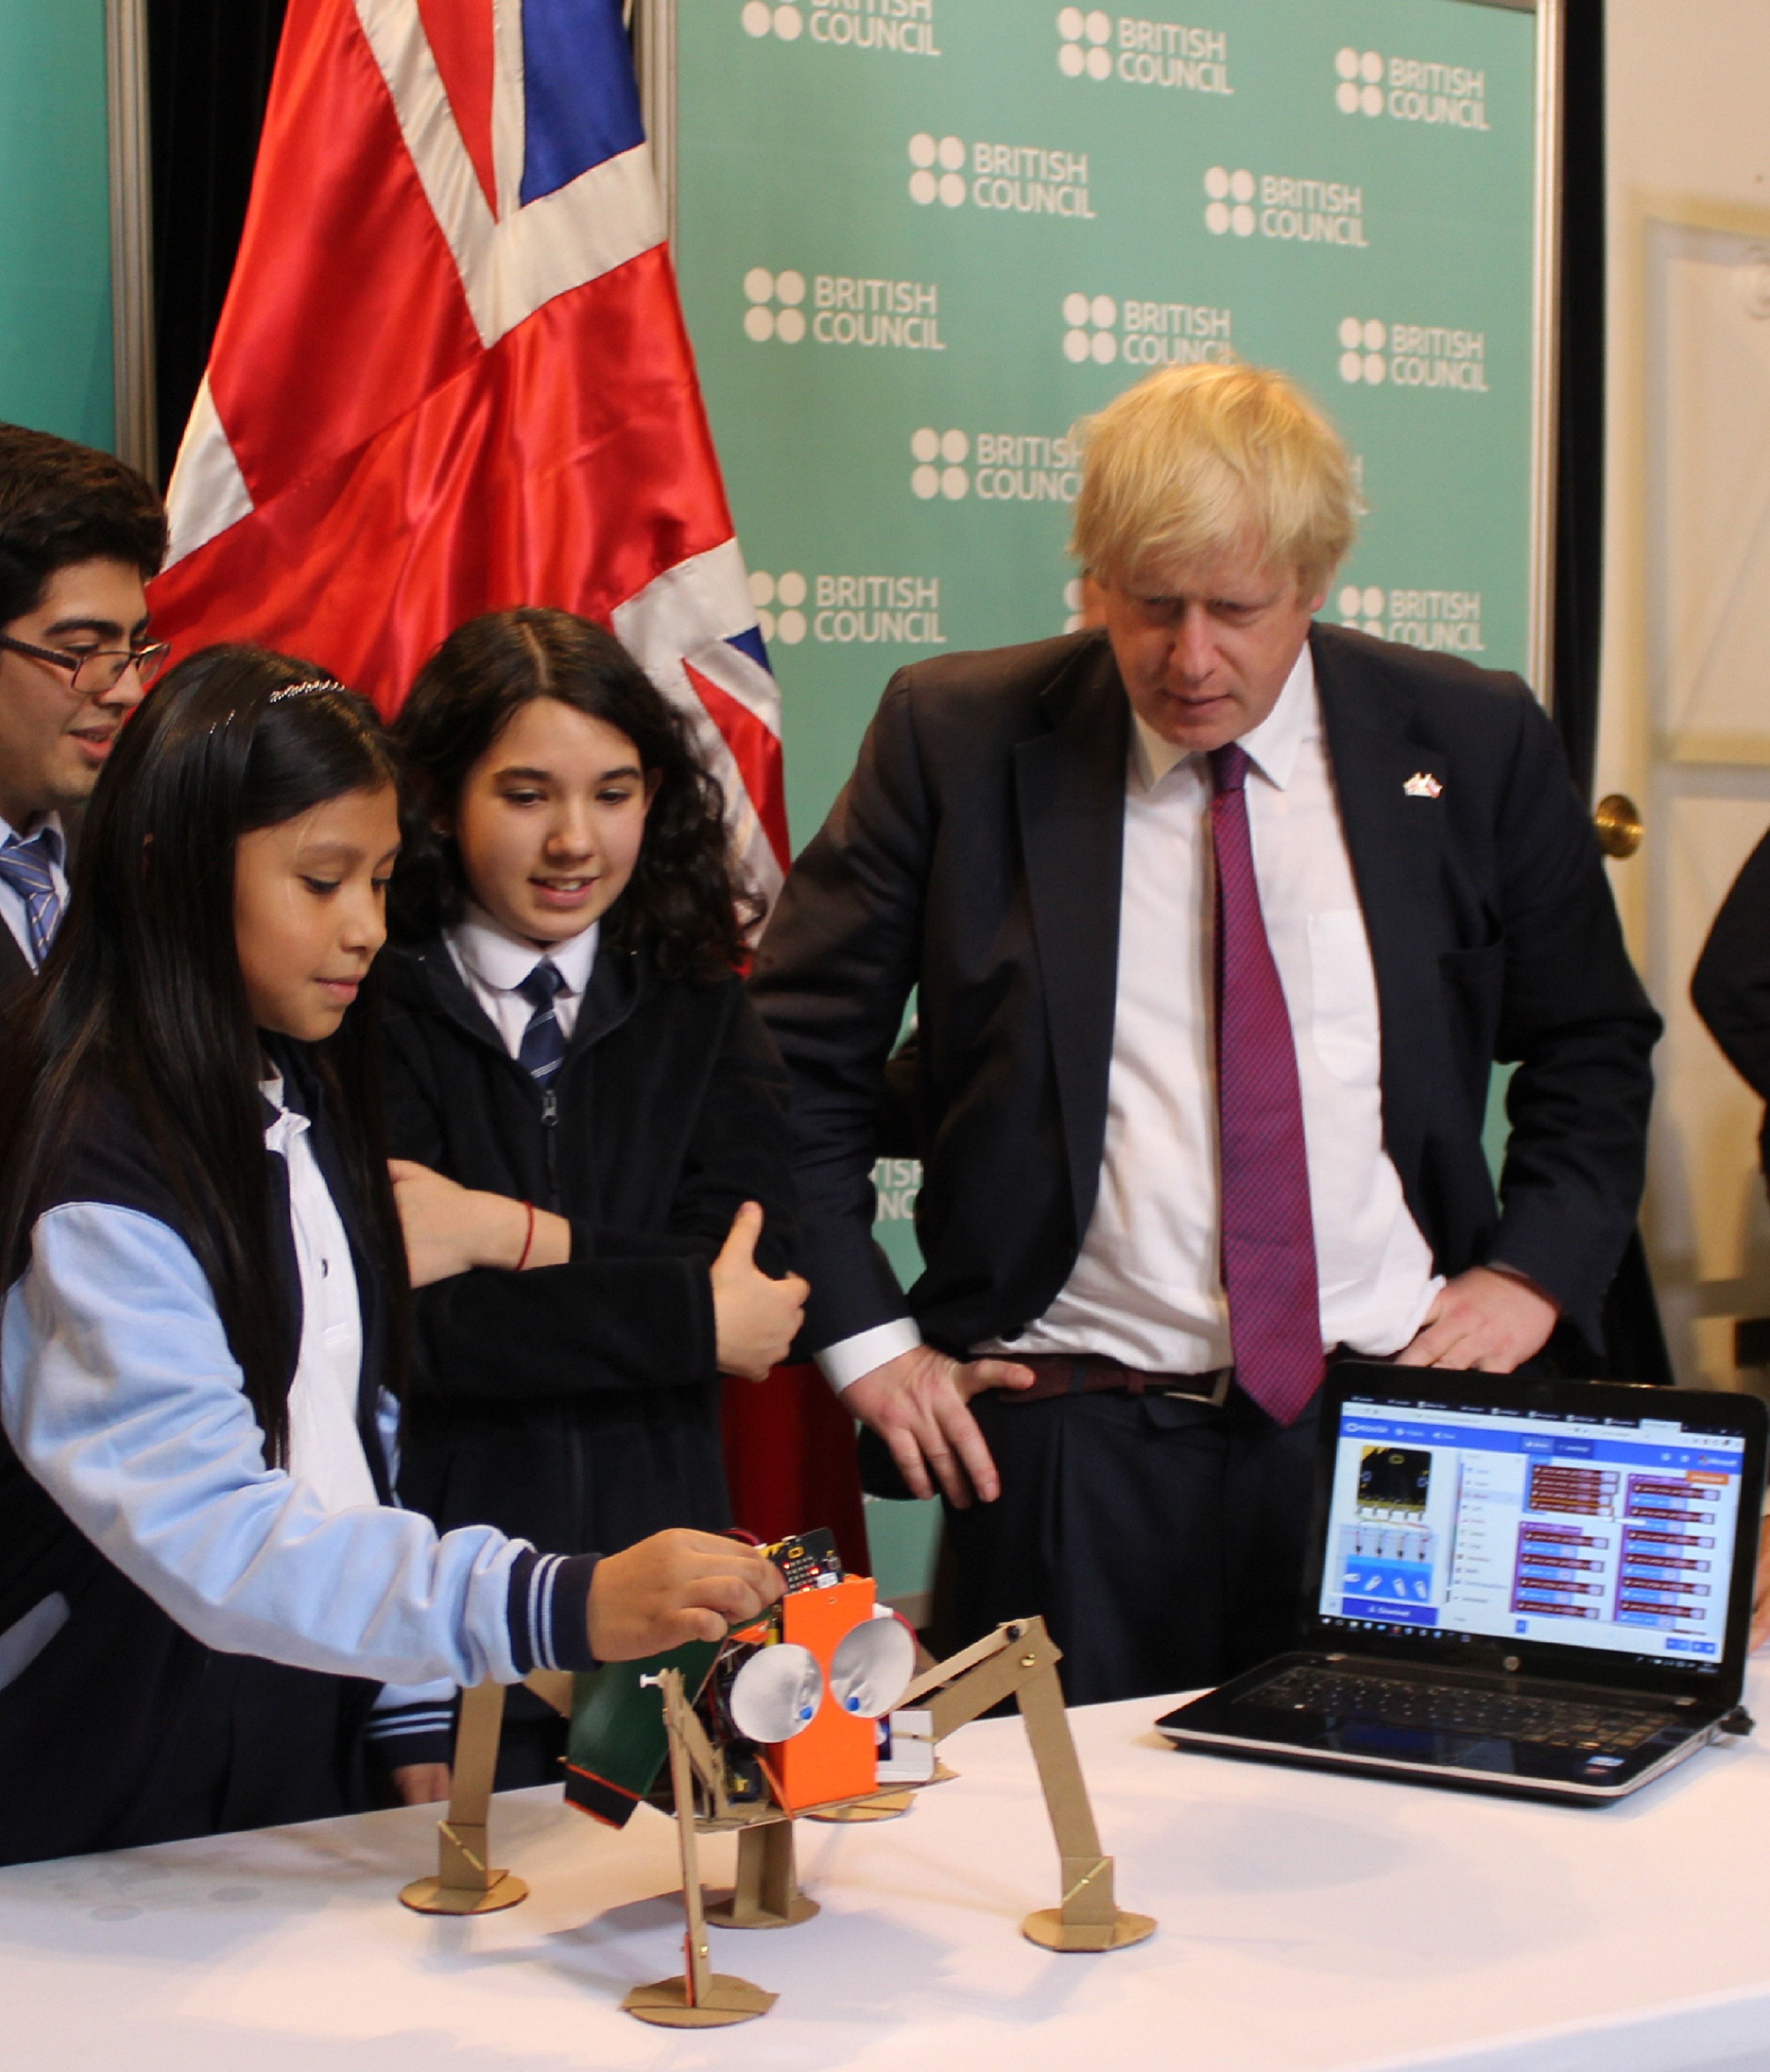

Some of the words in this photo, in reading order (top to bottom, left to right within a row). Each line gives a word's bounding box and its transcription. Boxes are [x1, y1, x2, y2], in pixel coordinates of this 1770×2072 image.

[809, 8, 942, 55] COUNCIL
[1118, 16, 1227, 61] BRITISH
[1117, 51, 1236, 94] COUNCIL
[1389, 57, 1485, 97] BRITISH
[1388, 91, 1491, 130] COUNCIL
[973, 142, 1089, 183] BRITISH
[972, 176, 1097, 218] COUNCIL
[1260, 175, 1363, 214] BRITISH
[1260, 207, 1370, 247] COUNCIL
[814, 274, 938, 314] BRITISH
[813, 310, 947, 350] COUNCIL
[1124, 300, 1232, 338] BRITISH
[1392, 323, 1485, 360] BRITISH
[1391, 356, 1490, 391] COUNCIL
[976, 468, 1084, 502] COUNCI
[815, 575, 940, 608] BRITISH
[1389, 590, 1481, 620] BRITISH
[814, 610, 948, 643] COUNCIL
[1388, 622, 1486, 651] COUNCIL
